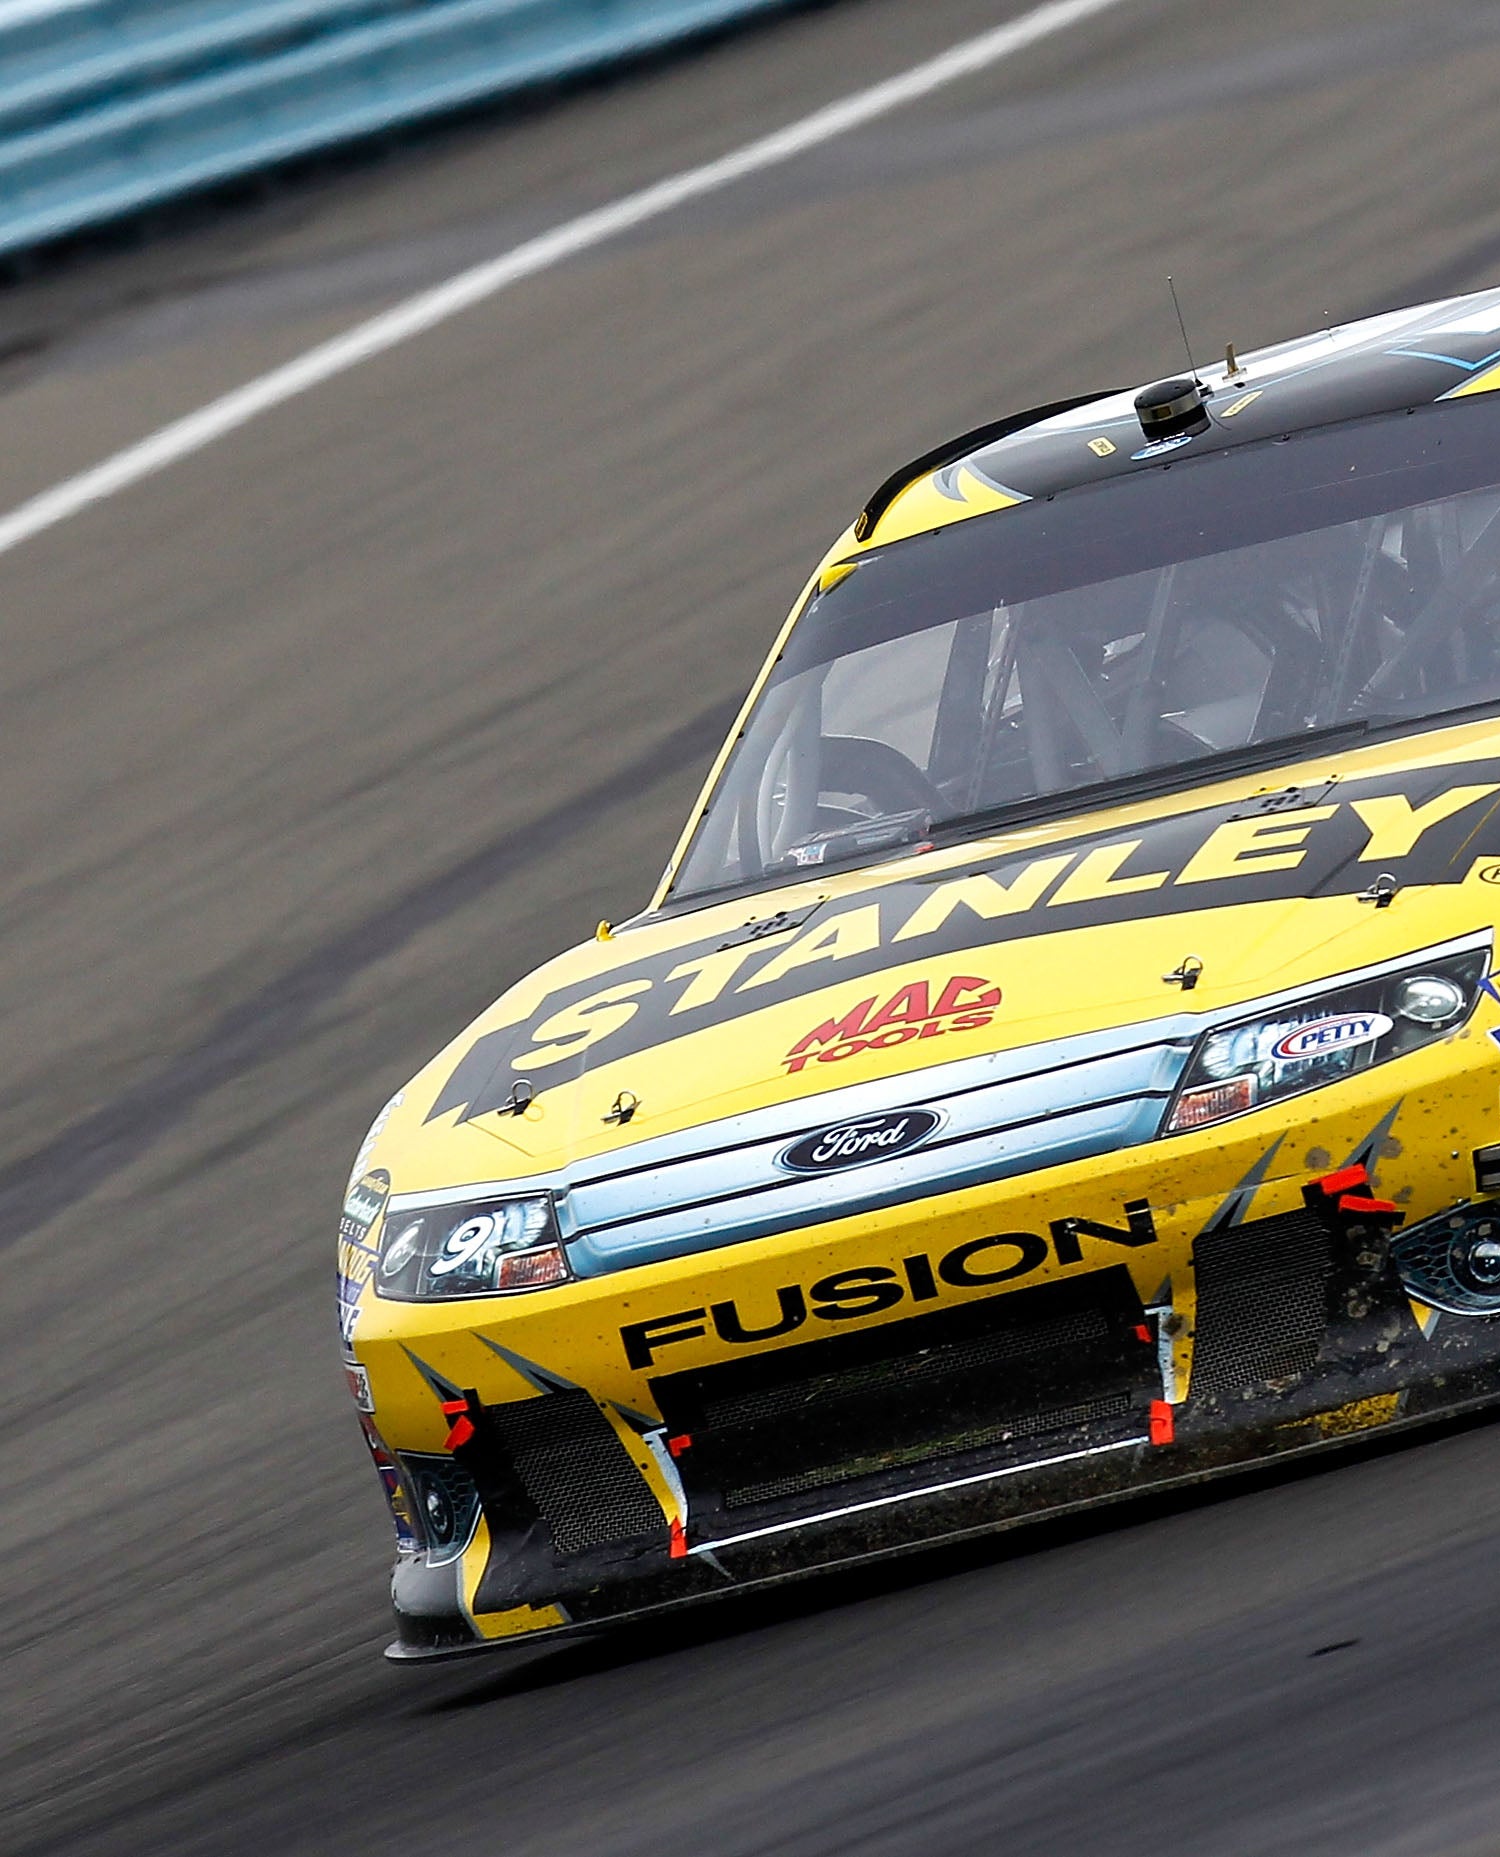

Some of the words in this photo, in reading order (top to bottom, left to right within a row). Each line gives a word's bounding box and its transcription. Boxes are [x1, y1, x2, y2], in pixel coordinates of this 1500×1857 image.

[781, 1010, 995, 1075] TOOLS
[786, 976, 1002, 1057] MAC
[1301, 1017, 1376, 1050] PETTY
[811, 1117, 910, 1162] Ford
[430, 1213, 496, 1278] 9
[620, 1198, 1158, 1371] FUSION
